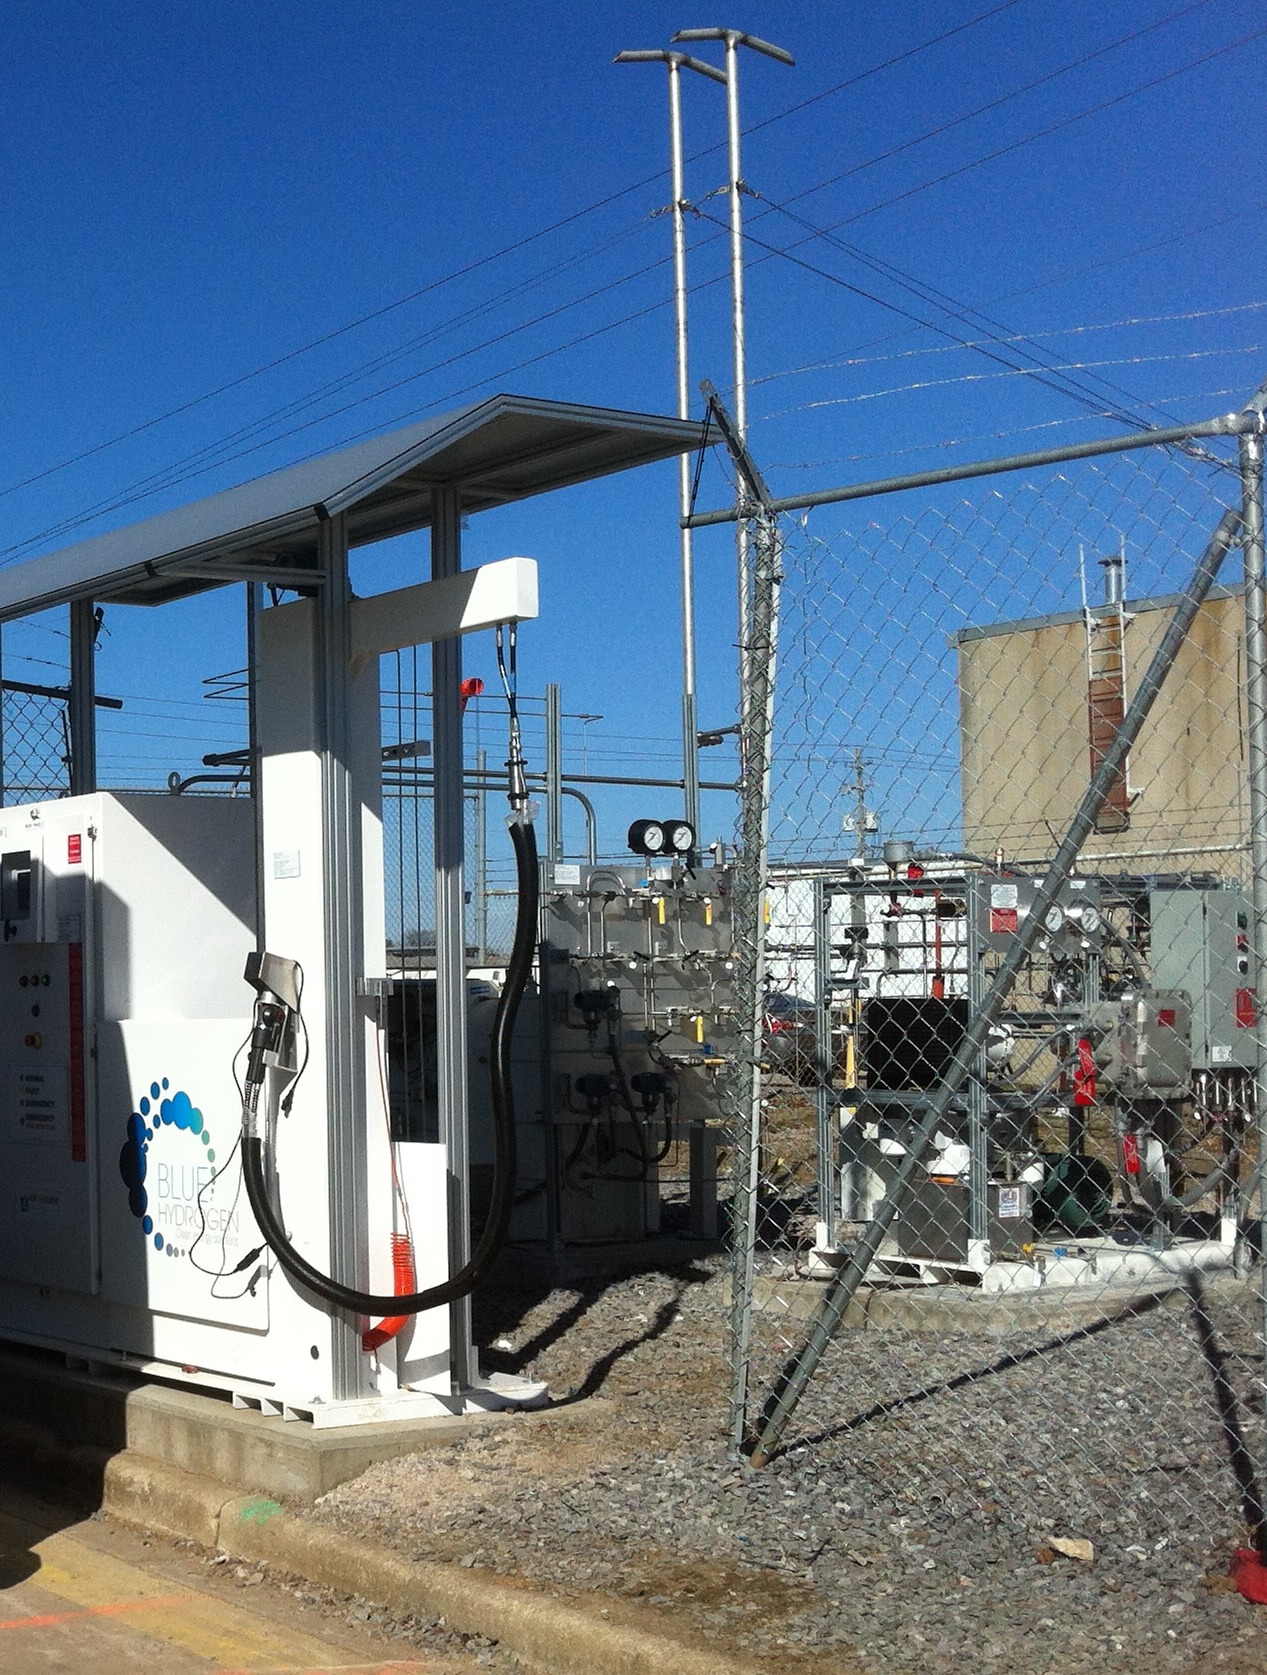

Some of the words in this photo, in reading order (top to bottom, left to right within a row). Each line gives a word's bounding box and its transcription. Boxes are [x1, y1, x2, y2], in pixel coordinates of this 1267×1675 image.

[157, 1162, 209, 1203] BLUE
[157, 1202, 239, 1233] HYDROGEN
[193, 1232, 212, 1245] enrgy
[213, 1234, 239, 1247] soltions
